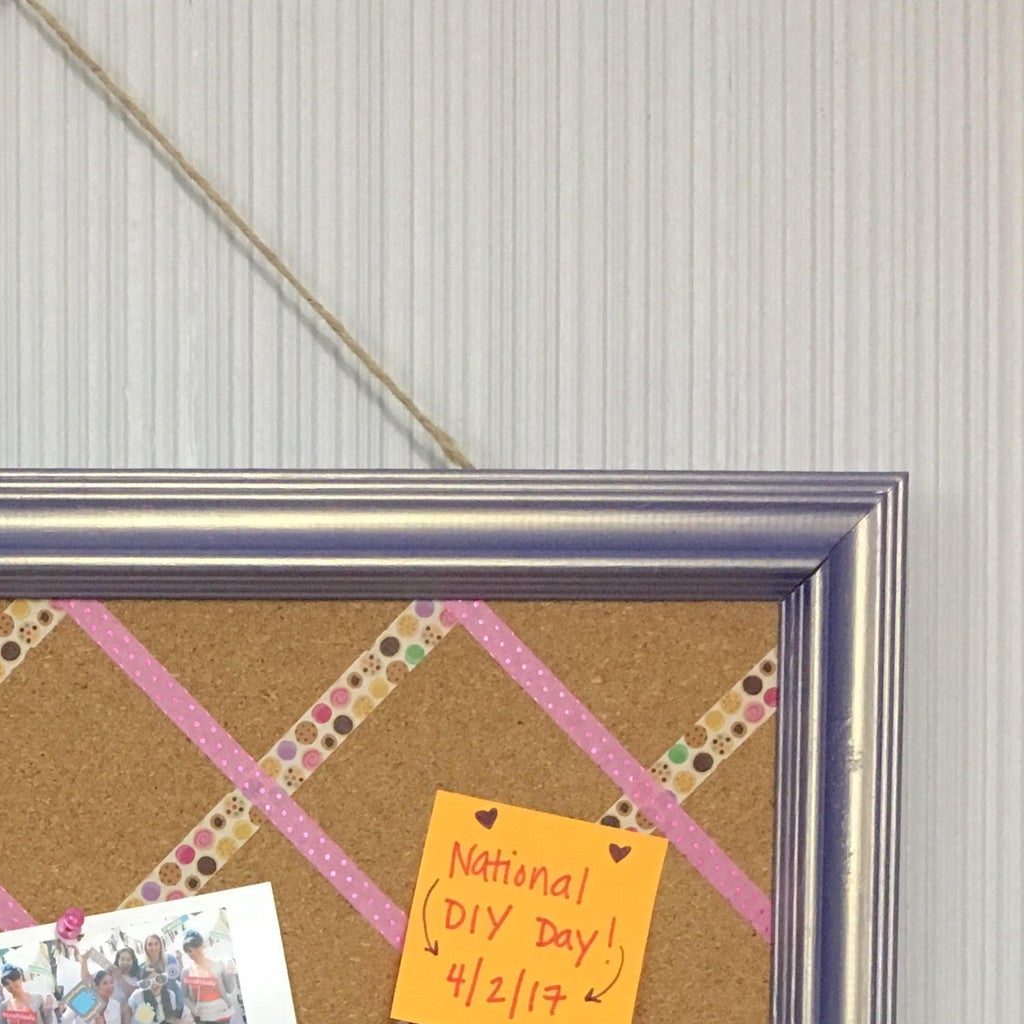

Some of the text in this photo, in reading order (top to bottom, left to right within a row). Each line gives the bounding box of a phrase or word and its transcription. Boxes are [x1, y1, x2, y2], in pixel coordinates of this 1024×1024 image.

[448, 841, 589, 905] National
[444, 898, 616, 968] DIY Day!
[446, 957, 567, 1020] 4/2/17
